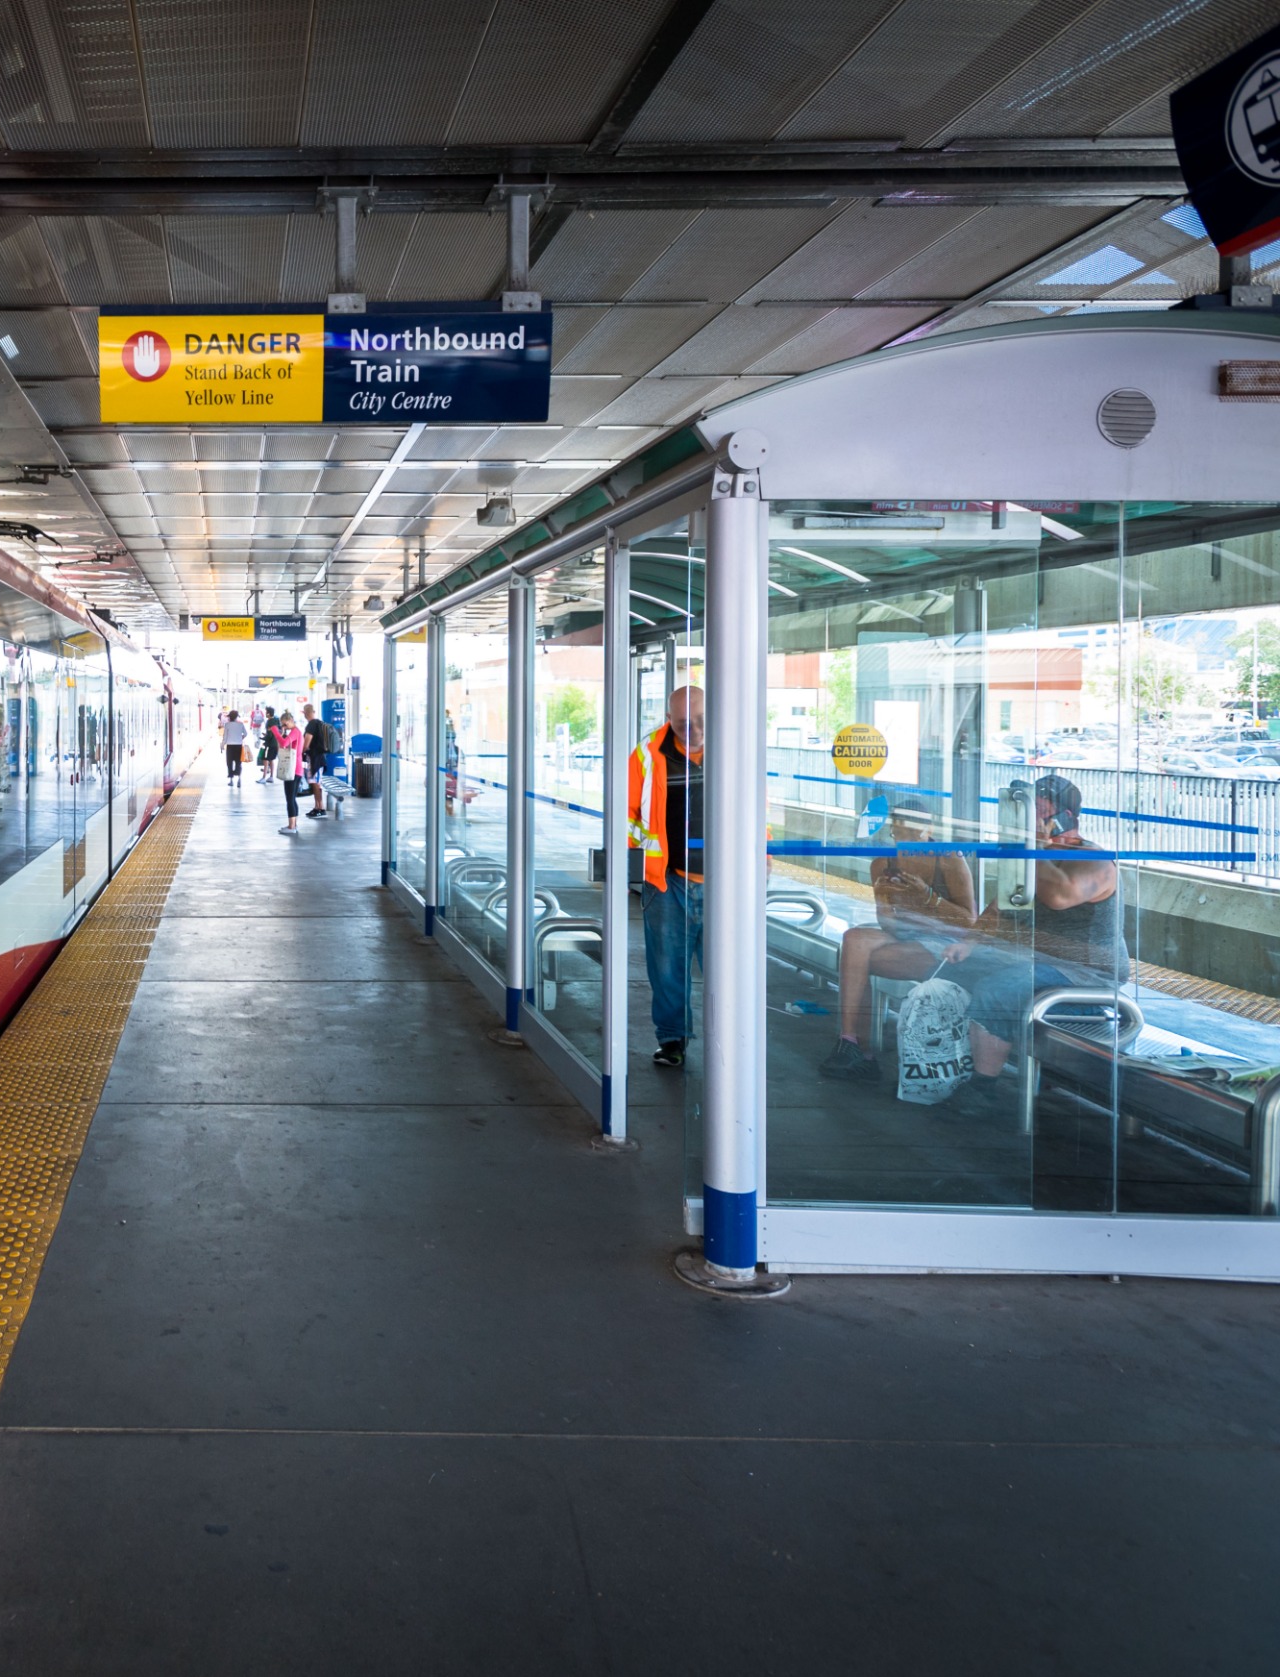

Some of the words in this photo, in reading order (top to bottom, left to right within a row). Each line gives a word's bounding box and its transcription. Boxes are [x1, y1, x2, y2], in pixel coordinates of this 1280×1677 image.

[184, 332, 302, 355] DANGER
[349, 325, 526, 352] Northbound
[184, 363, 228, 381] Stand
[233, 362, 272, 380] Back
[277, 362, 294, 380] of
[349, 358, 421, 383] Train
[184, 389, 237, 406] Yellow
[241, 389, 275, 406] Line
[348, 391, 387, 415] City
[391, 391, 453, 410] Centre
[259, 620, 301, 628] Northbound
[836, 735, 885, 743] AUTOMATIC
[834, 746, 887, 757] CAUTION
[848, 760, 873, 768] DOOR
